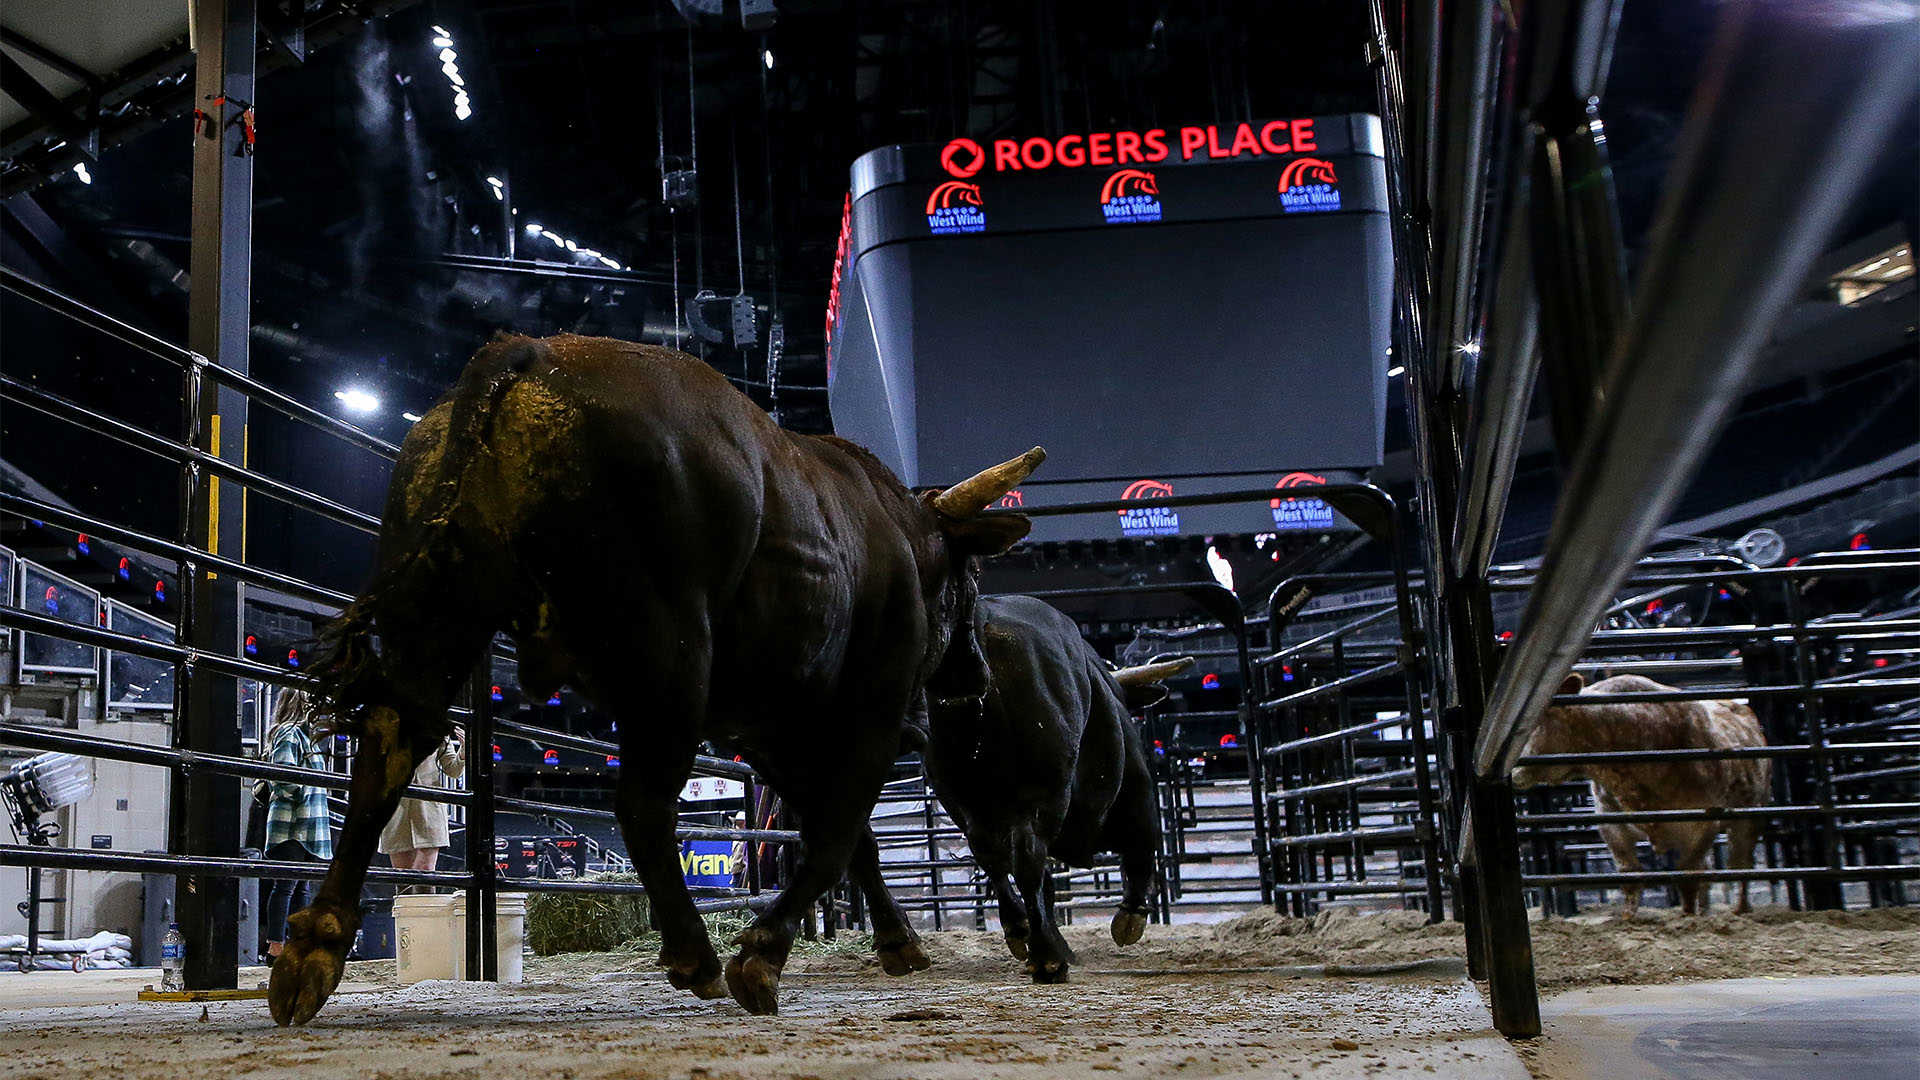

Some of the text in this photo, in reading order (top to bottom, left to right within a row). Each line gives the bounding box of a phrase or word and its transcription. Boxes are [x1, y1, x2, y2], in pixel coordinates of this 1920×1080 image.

[993, 118, 1318, 172] ROGERS PLACE
[1280, 189, 1341, 206] West Wind
[1103, 201, 1161, 217] West Wind
[928, 211, 985, 228] West Wind
[1120, 512, 1178, 529] West Wind
[1272, 505, 1333, 522] West Wind
